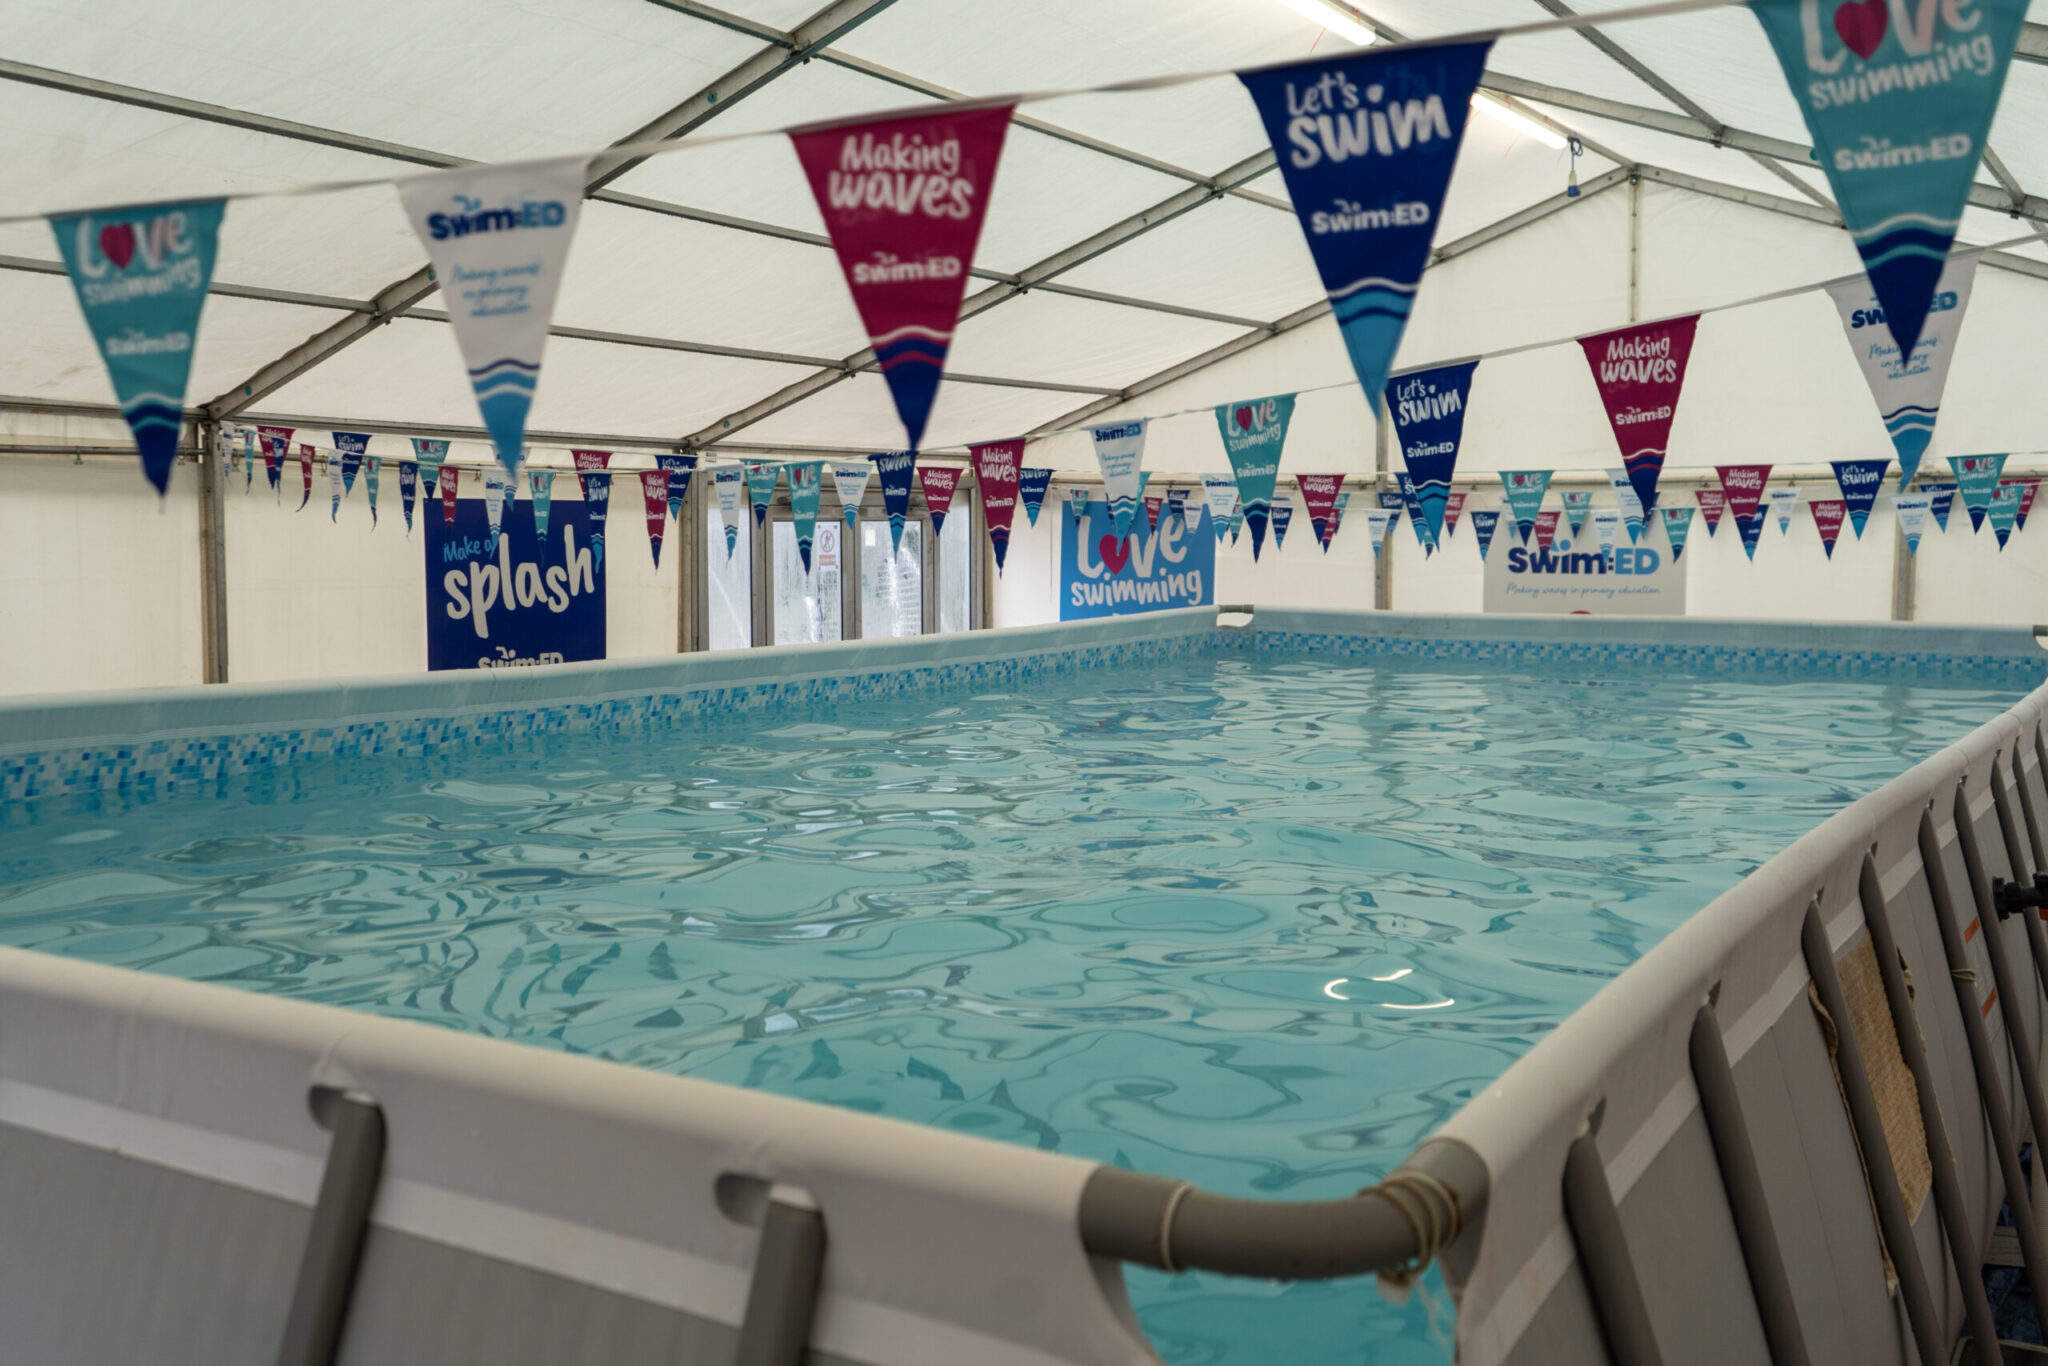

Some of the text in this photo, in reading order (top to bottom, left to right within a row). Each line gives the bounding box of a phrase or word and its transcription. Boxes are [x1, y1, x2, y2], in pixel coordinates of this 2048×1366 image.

[1809, 34, 1995, 110] swimming
[1286, 71, 1360, 116] Let's
[841, 132, 960, 177] Making
[828, 169, 974, 220] waves
[1607, 336, 1670, 361] Making
[1600, 358, 1677, 384] waves
[1397, 379, 1426, 402] Let's
[1229, 423, 1282, 452] swimming
[982, 448, 1013, 465] Making
[979, 463, 1018, 483] waves
[443, 536, 481, 563] Make
[443, 524, 595, 639] splash
[1071, 568, 1203, 607] swimming
